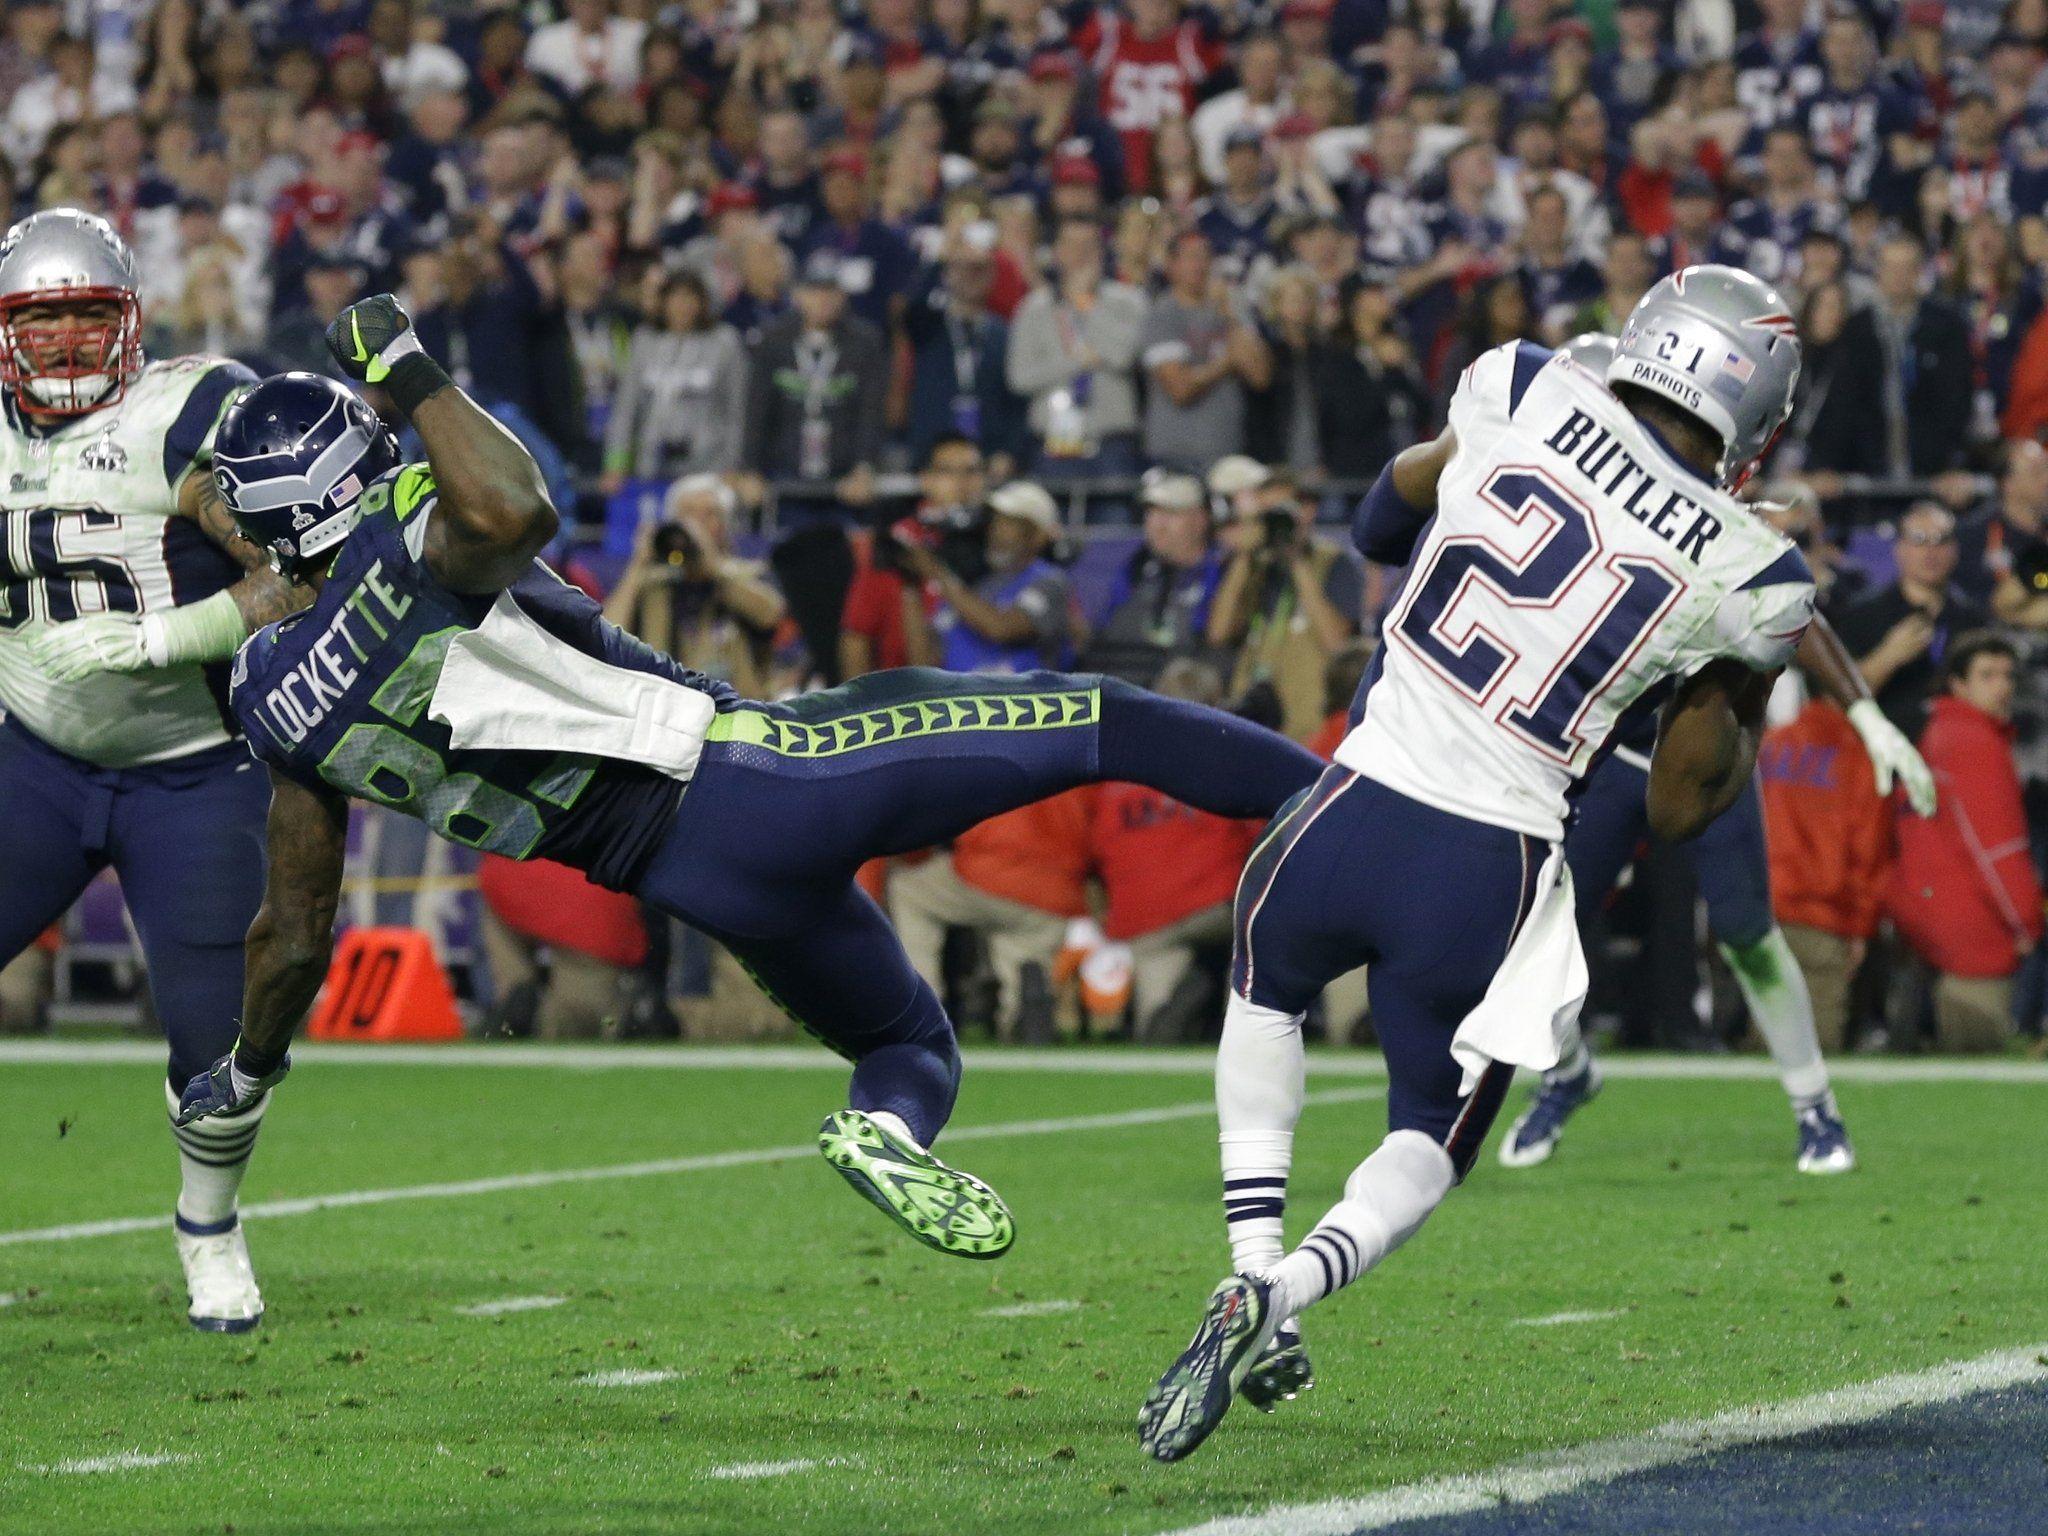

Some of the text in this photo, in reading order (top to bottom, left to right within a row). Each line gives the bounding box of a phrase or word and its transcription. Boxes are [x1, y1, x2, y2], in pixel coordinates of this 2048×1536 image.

[1632, 362, 1704, 409] PATRIOTS
[1656, 331, 1705, 374] 21
[1544, 407, 1722, 565] BUTLER
[253, 557, 413, 753] LOCKETTE
[1390, 465, 1688, 766] 21
[326, 946, 402, 1031] 10
